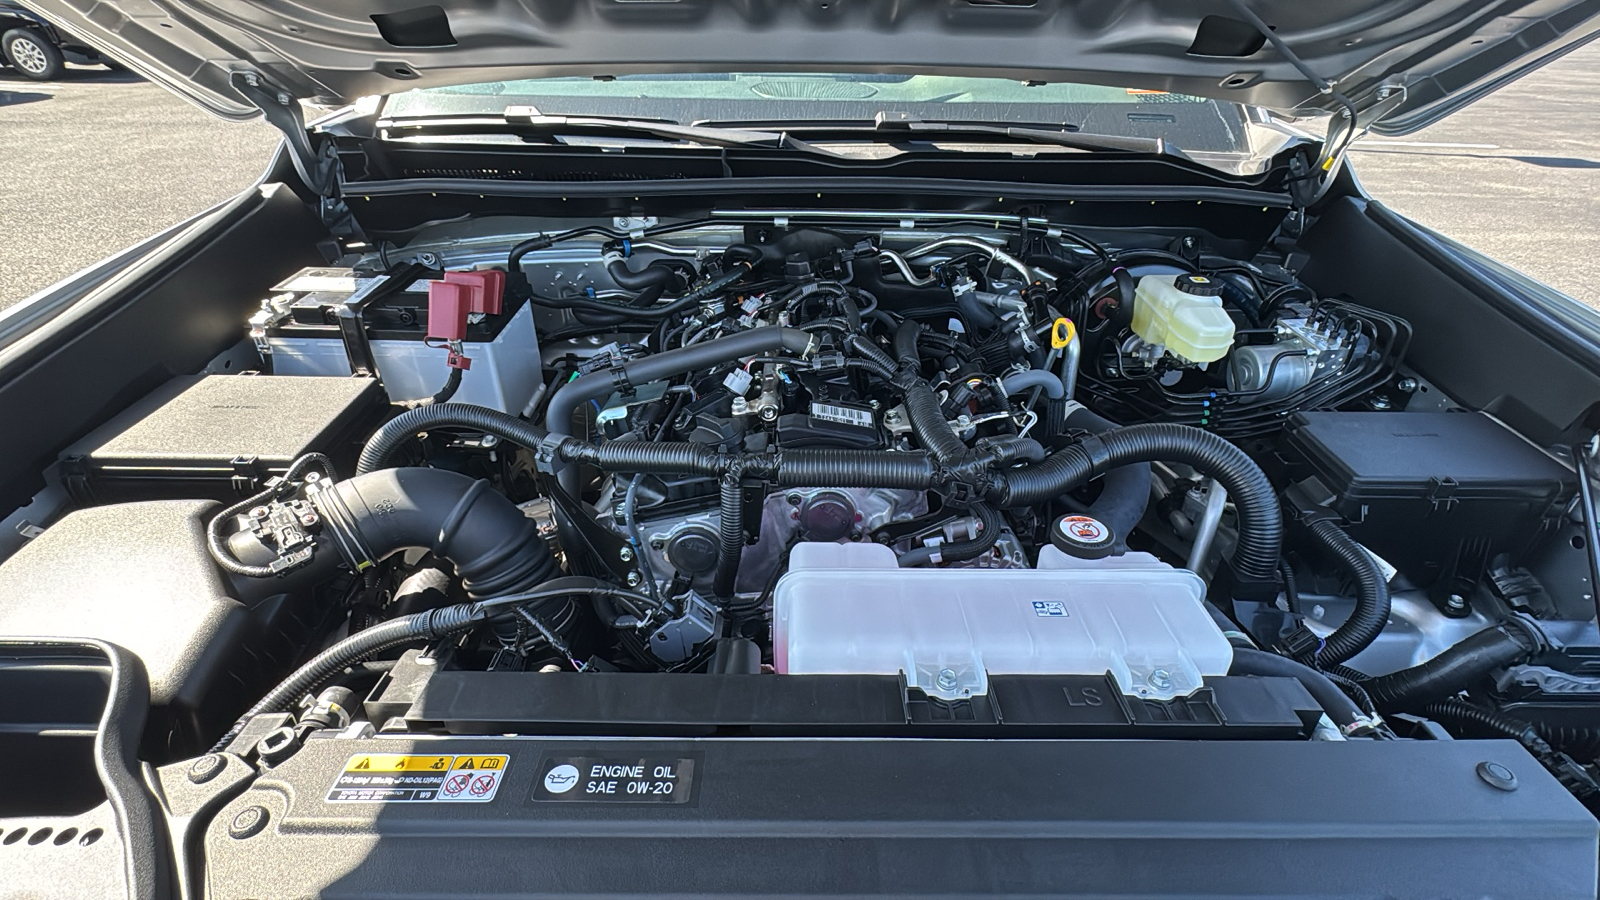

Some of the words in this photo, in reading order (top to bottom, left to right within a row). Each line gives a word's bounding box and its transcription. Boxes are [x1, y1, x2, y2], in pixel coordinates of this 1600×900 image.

[1062, 686, 1103, 707] LS
[590, 765, 645, 778] ENGINE
[653, 766, 676, 778] OIL
[586, 781, 618, 794] SAE
[626, 781, 673, 794] 0W-20
